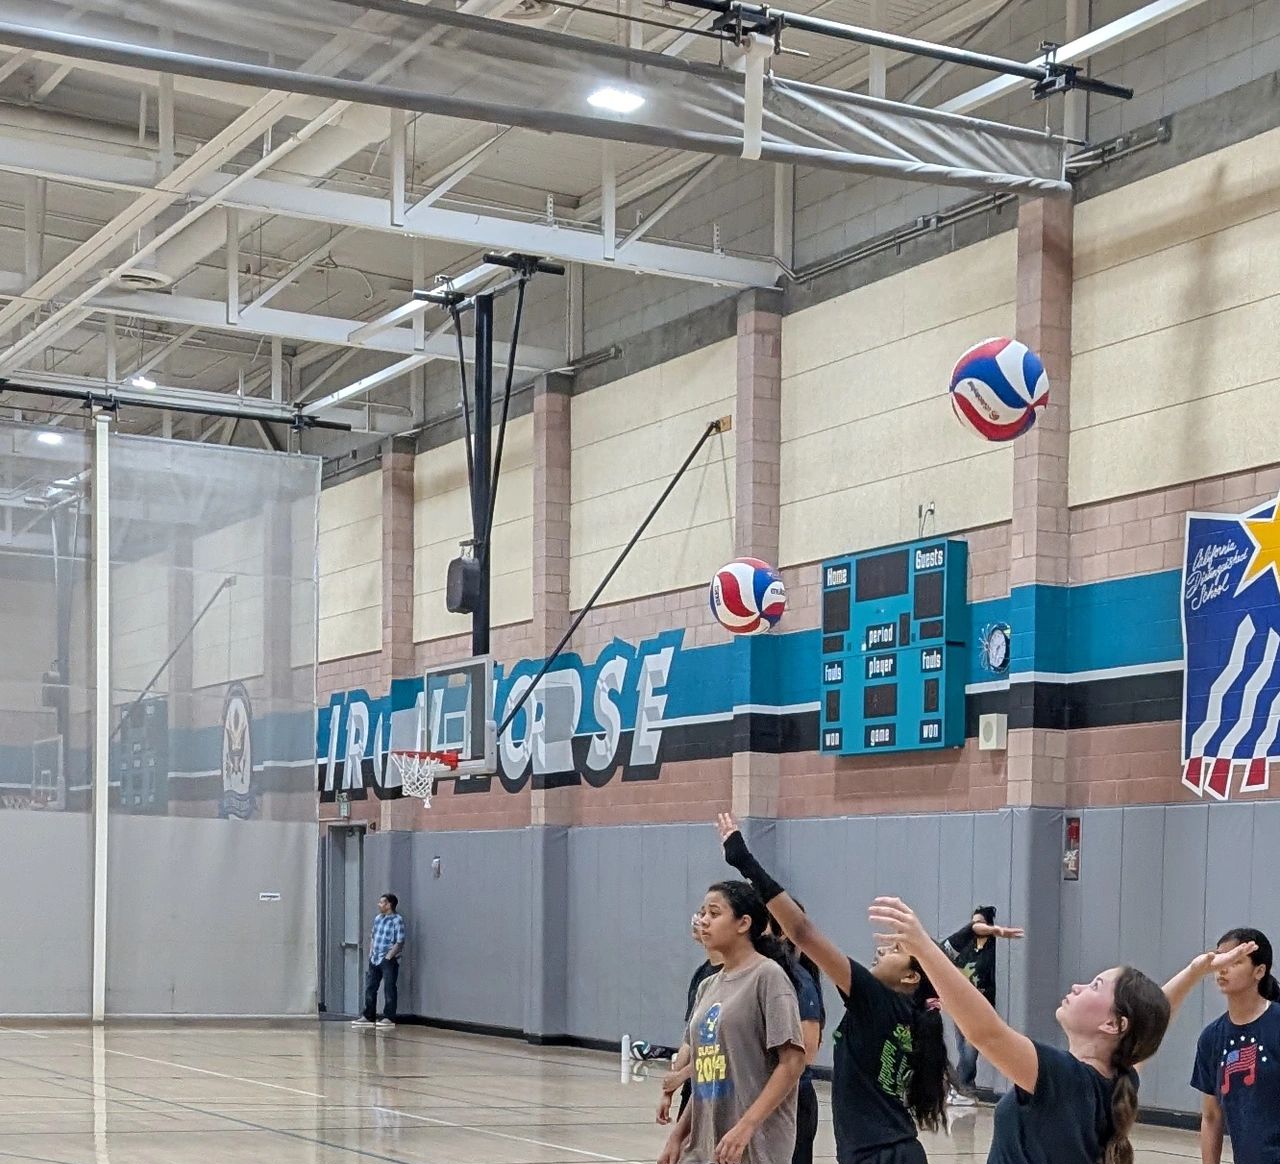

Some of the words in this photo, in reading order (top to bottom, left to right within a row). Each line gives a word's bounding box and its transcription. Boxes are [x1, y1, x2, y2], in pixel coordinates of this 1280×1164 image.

[826, 566, 847, 586] Home
[915, 548, 944, 570] Guests
[1191, 573, 1230, 610] School
[868, 623, 894, 644] period
[868, 657, 894, 679] player
[922, 650, 942, 670] fouls
[824, 664, 842, 682] fouls
[463, 646, 676, 783] ORSE
[824, 732, 841, 747] won
[870, 728, 890, 747] game
[922, 723, 940, 739] won
